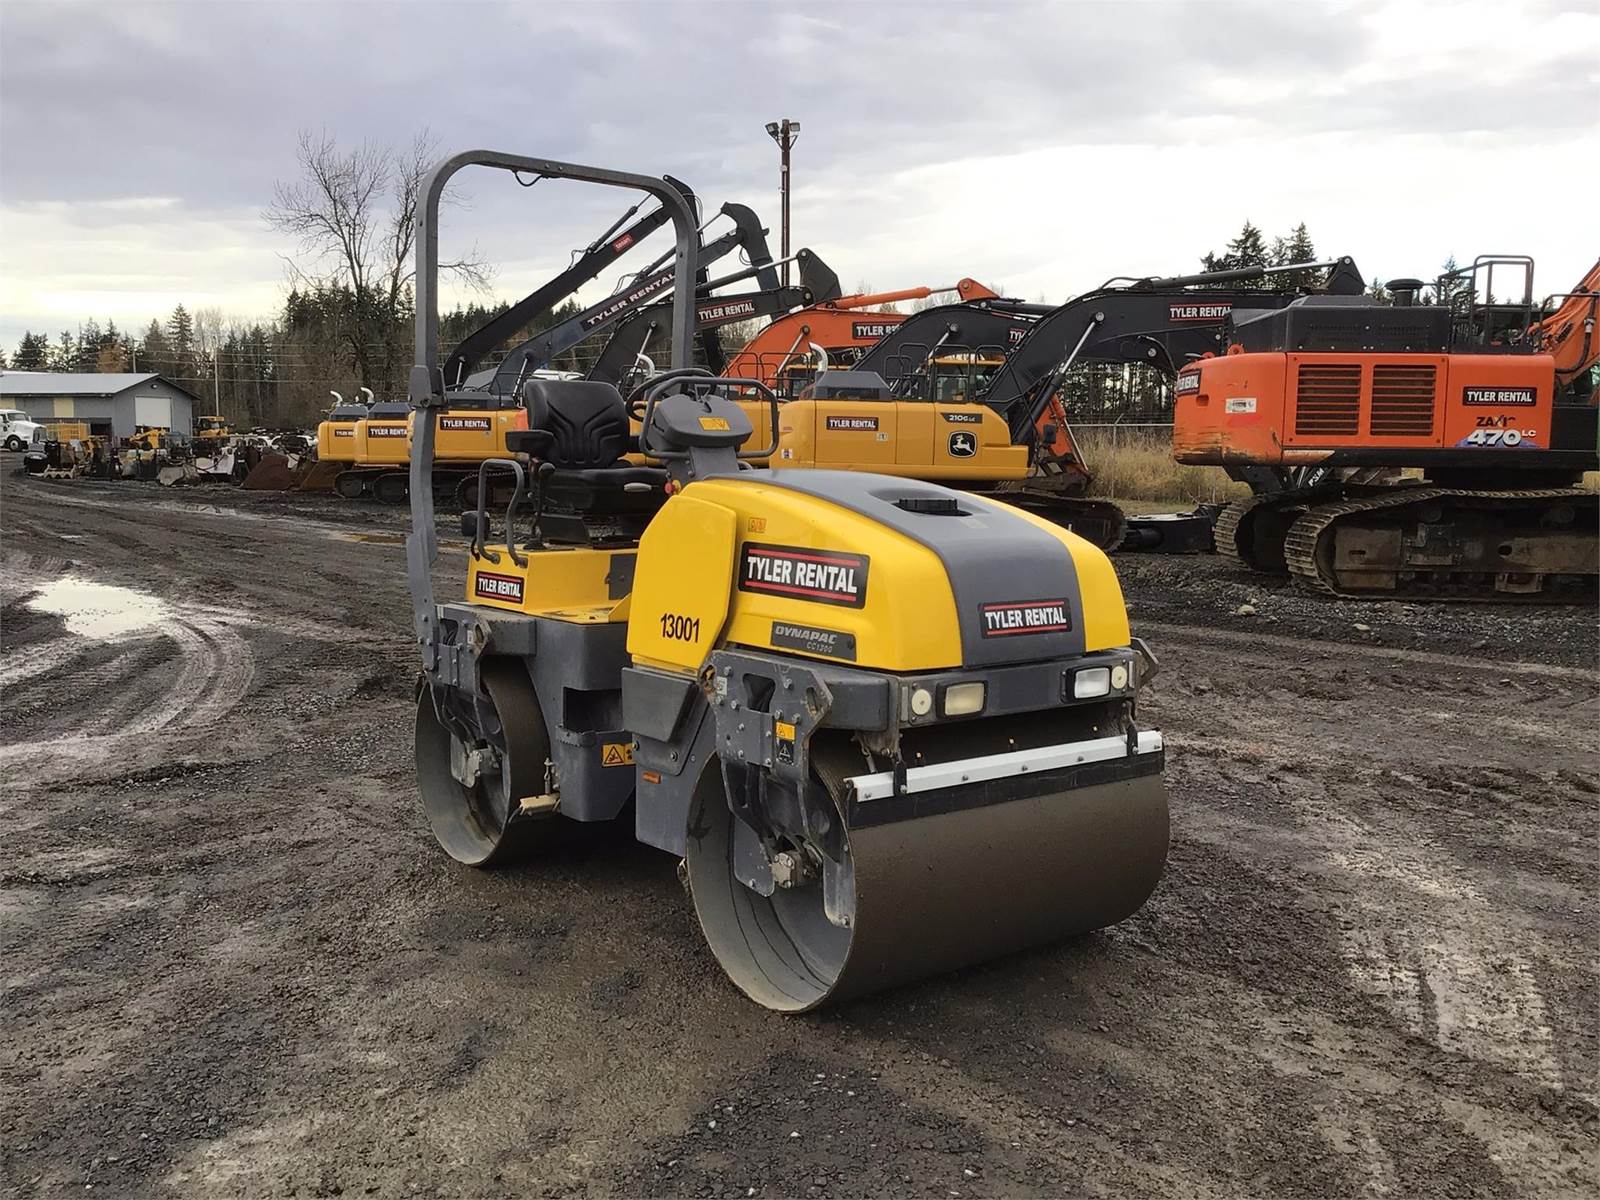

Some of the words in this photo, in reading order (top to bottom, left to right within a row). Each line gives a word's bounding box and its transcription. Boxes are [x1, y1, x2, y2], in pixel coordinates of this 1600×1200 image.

[587, 300, 627, 325] TYLER
[629, 273, 675, 302] RENTAL
[698, 307, 725, 320] TYLER
[724, 302, 755, 316] RENTAL
[1170, 307, 1198, 318] TYLER
[856, 325, 884, 336] TYLER
[1467, 391, 1496, 402] TYLER
[1497, 391, 1532, 402] RENTAL
[370, 428, 389, 436] TYLER
[389, 428, 408, 436] RENTA
[443, 419, 463, 428] TYLER
[464, 420, 489, 428] RENTAL
[829, 419, 850, 428] TYLER
[850, 420, 876, 428] RENTAL
[1467, 429, 1521, 447] 470
[1521, 429, 1537, 437] LC
[747, 556, 792, 584] TYLER
[795, 562, 858, 593] RENTAL
[478, 577, 497, 593] TYLER
[497, 580, 521, 597] RENTAL
[661, 612, 700, 643] 13001
[985, 609, 1023, 630] TYLER
[1024, 607, 1067, 626] RENTAL
[775, 625, 838, 644] DYNAPAC
